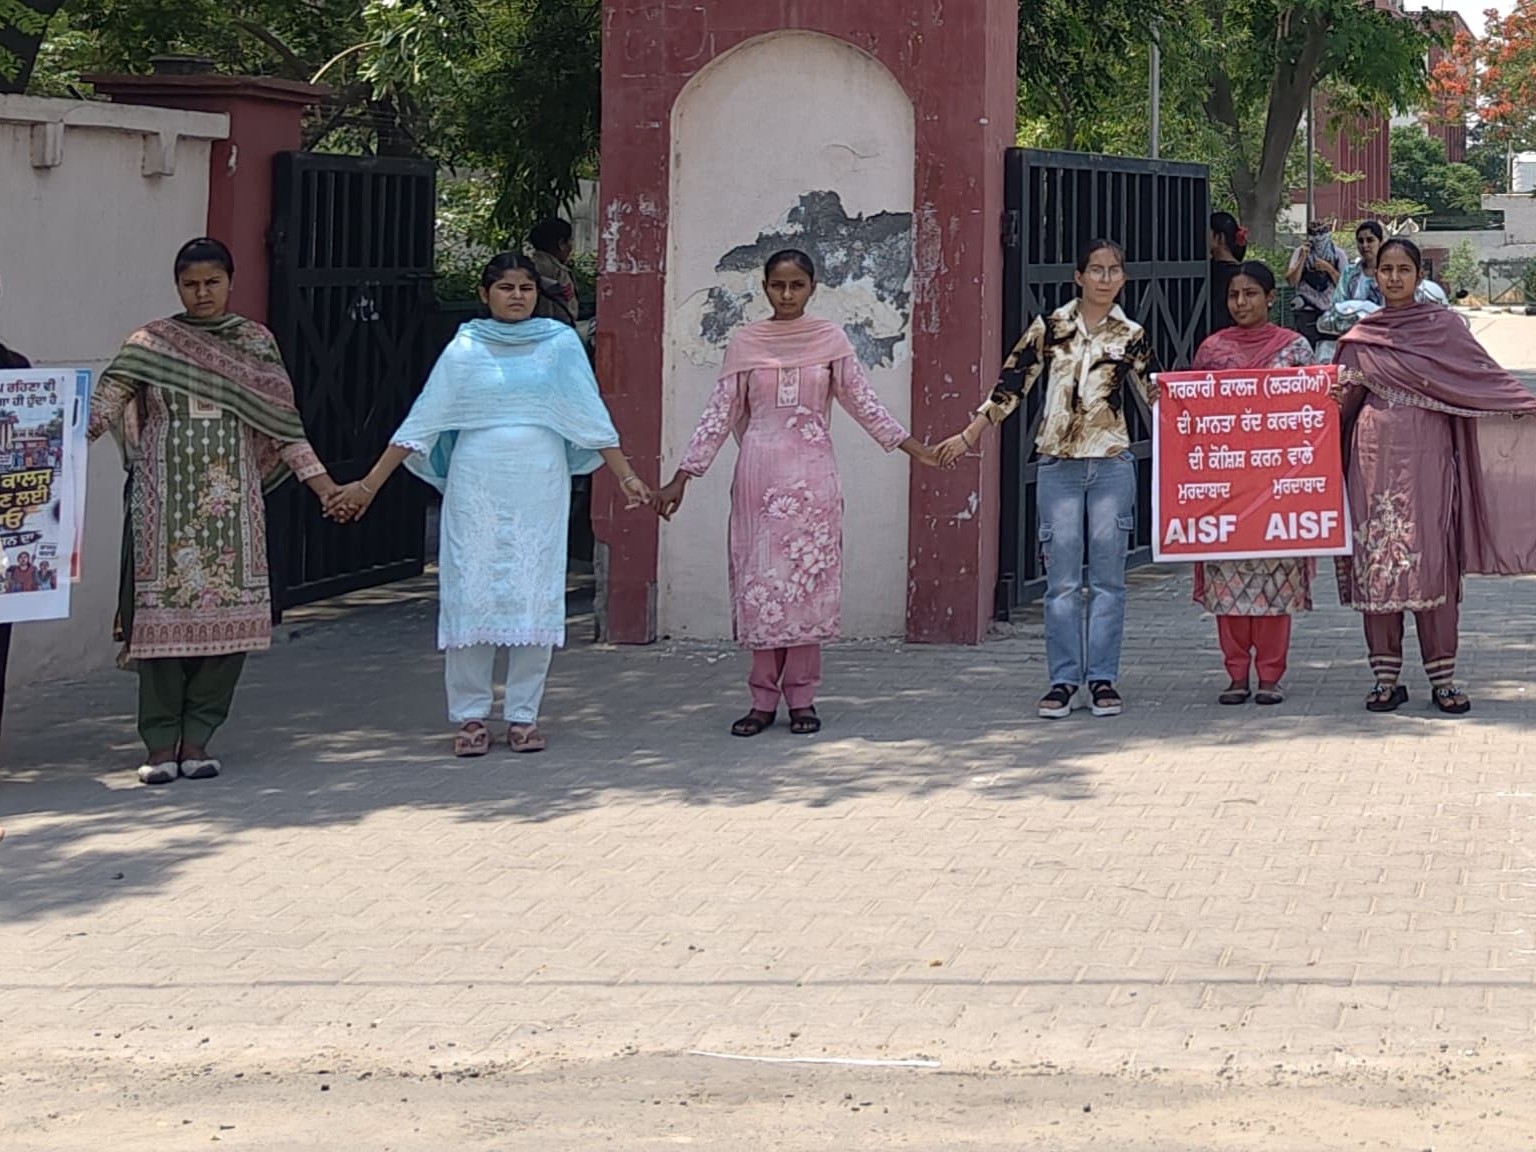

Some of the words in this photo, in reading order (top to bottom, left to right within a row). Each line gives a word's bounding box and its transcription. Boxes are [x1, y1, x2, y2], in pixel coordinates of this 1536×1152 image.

[1166, 374, 1216, 400] ਸਰਕਾਰੀ
[1220, 377, 1259, 397] ਕਾਲਜ
[1263, 369, 1332, 399] (ਲੜਕੀਆਂ)
[1176, 410, 1191, 435] ਦੀ
[1195, 414, 1236, 434] ਮਾਨਤਾ
[1240, 409, 1262, 432] ਰੱਦ
[1266, 404, 1326, 433] ਕਰਵਾਉਣ
[1188, 446, 1204, 470] ਦੀ
[1250, 449, 1282, 467] ਕਰਨ
[1286, 441, 1315, 466] ਵਾਲੇ
[1, 469, 53, 489] ਕਾਲਜ
[1177, 482, 1232, 504] ਮੁਰਦਾਬਾਦ
[1272, 477, 1327, 499] ਮੁਰਦਾਬਾਦ
[1164, 514, 1237, 545] AISF
[1265, 511, 1339, 541] AISF
